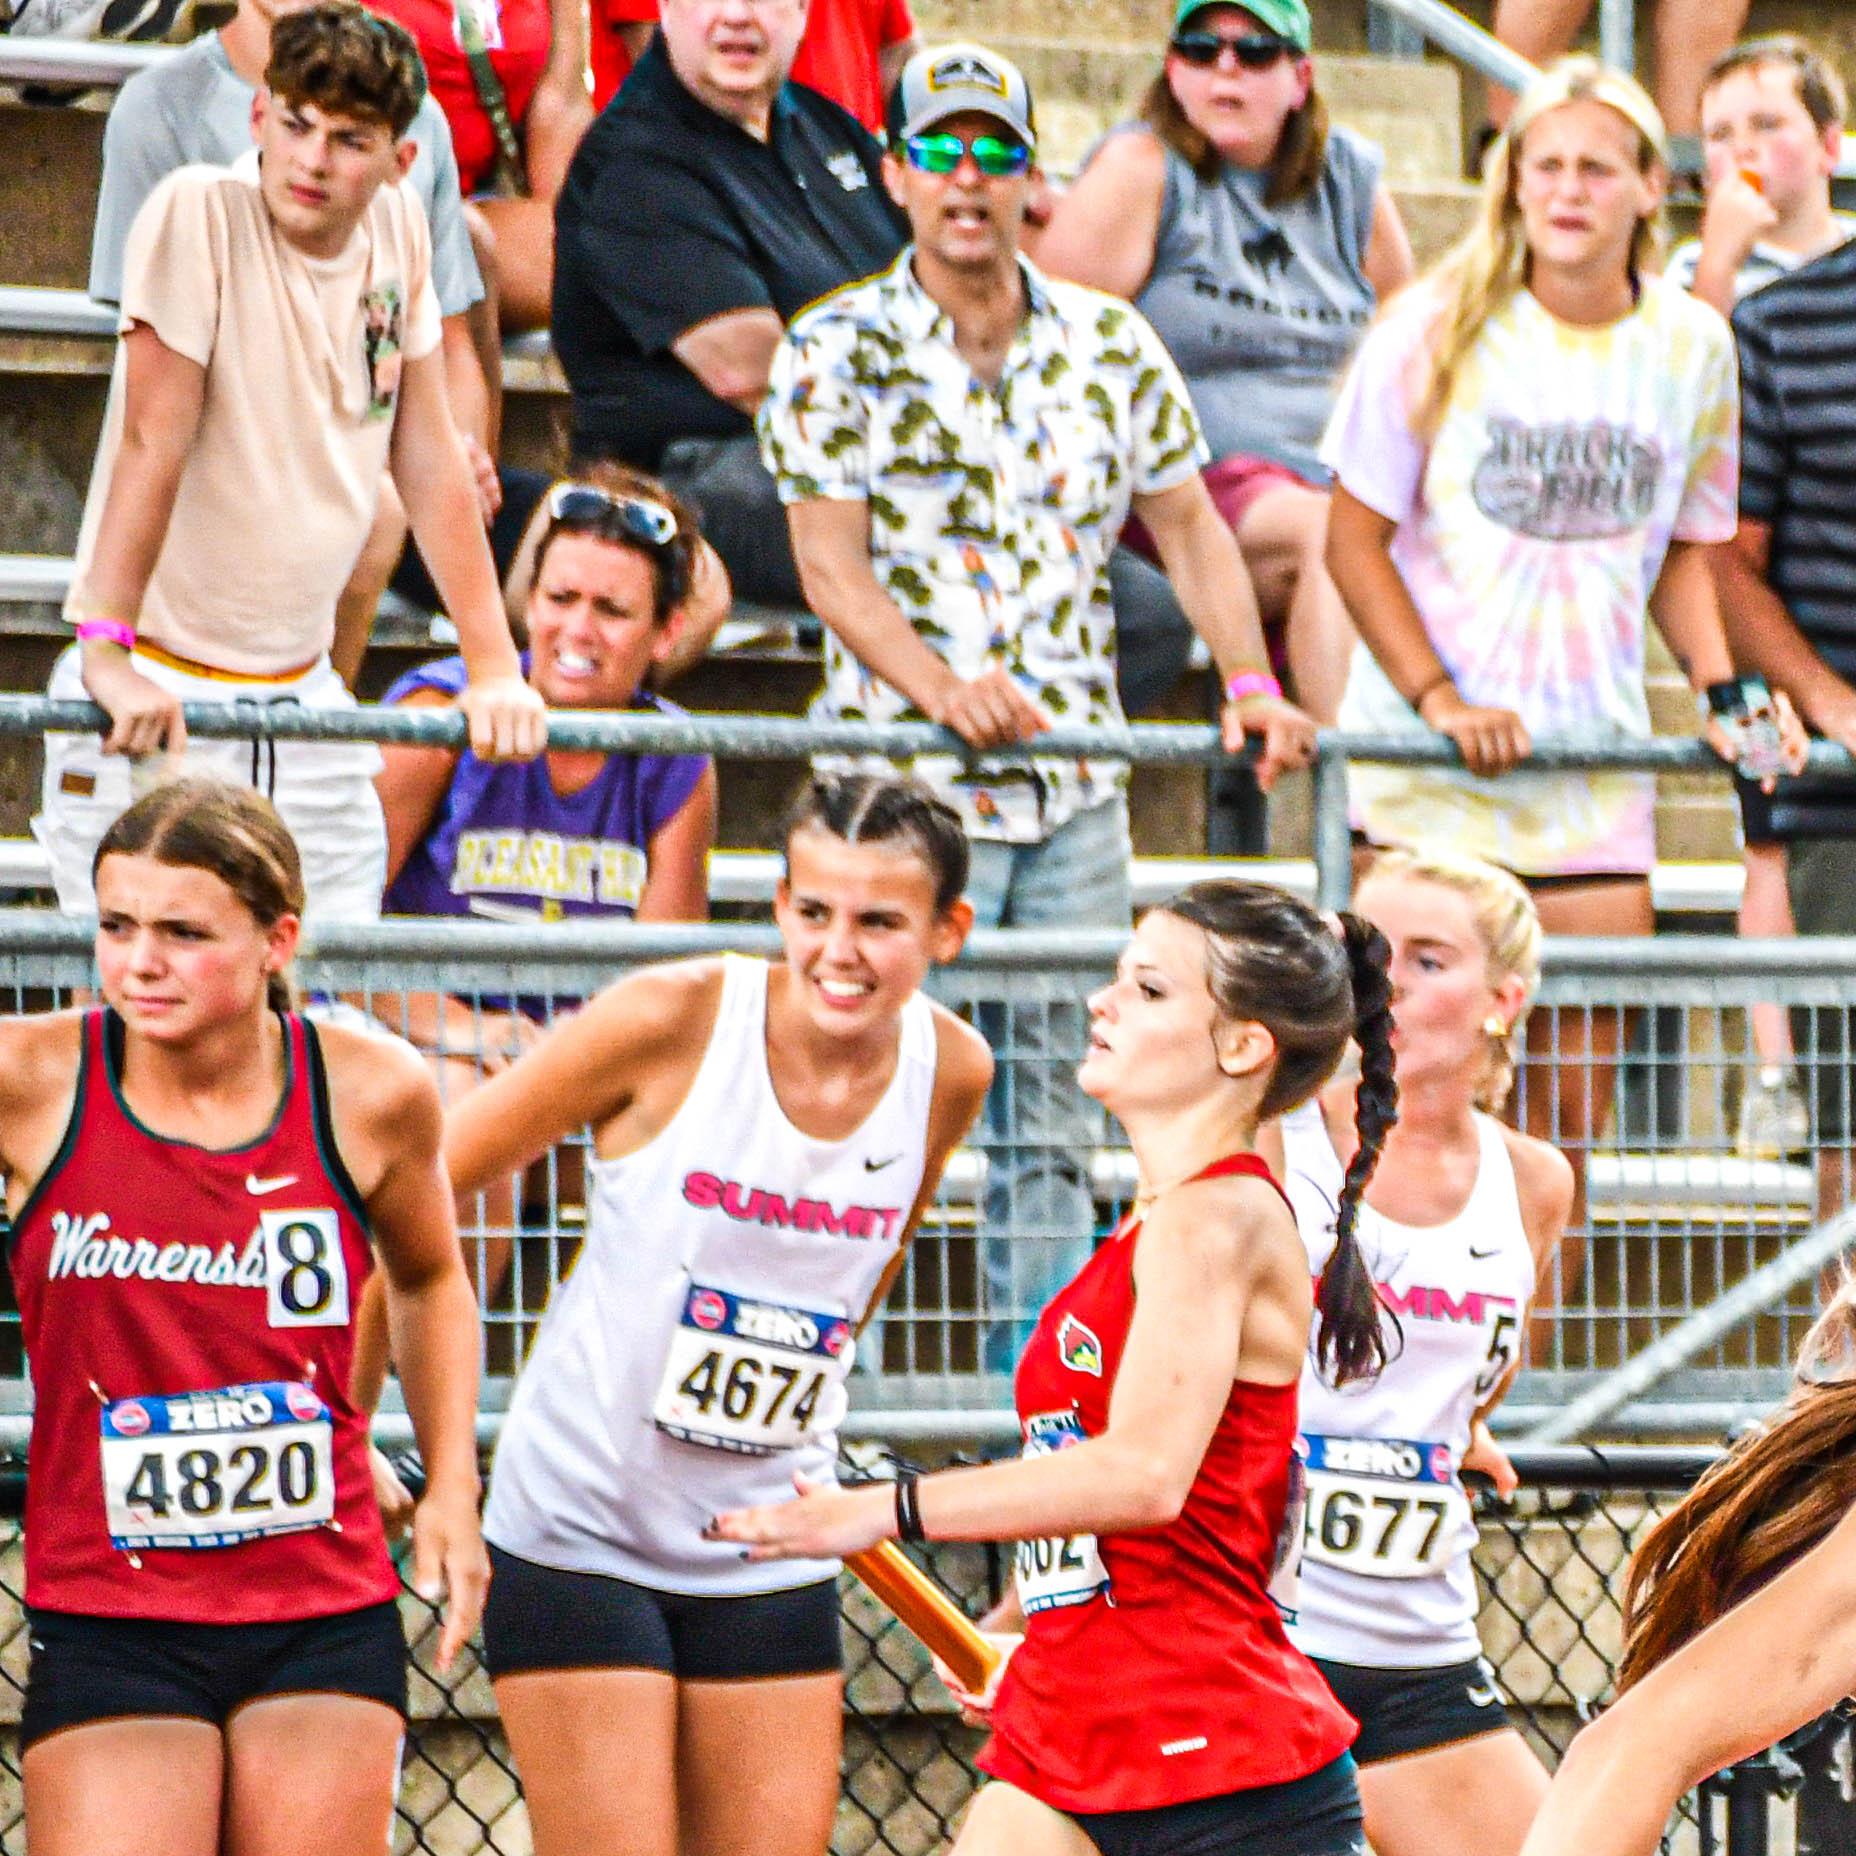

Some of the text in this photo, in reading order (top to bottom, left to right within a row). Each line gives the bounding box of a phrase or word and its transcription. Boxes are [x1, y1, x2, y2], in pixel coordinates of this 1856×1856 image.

[682, 1170, 901, 1240] SUMMIT
[49, 1211, 269, 1288] Warrensb
[278, 1221, 335, 1316] 8
[734, 1301, 820, 1350] ZERO
[1473, 1314, 1517, 1396] 5
[166, 1391, 274, 1432] ZERO
[677, 1348, 827, 1432] 4674
[125, 1440, 319, 1519] 4820
[1324, 1437, 1422, 1480] ZERO
